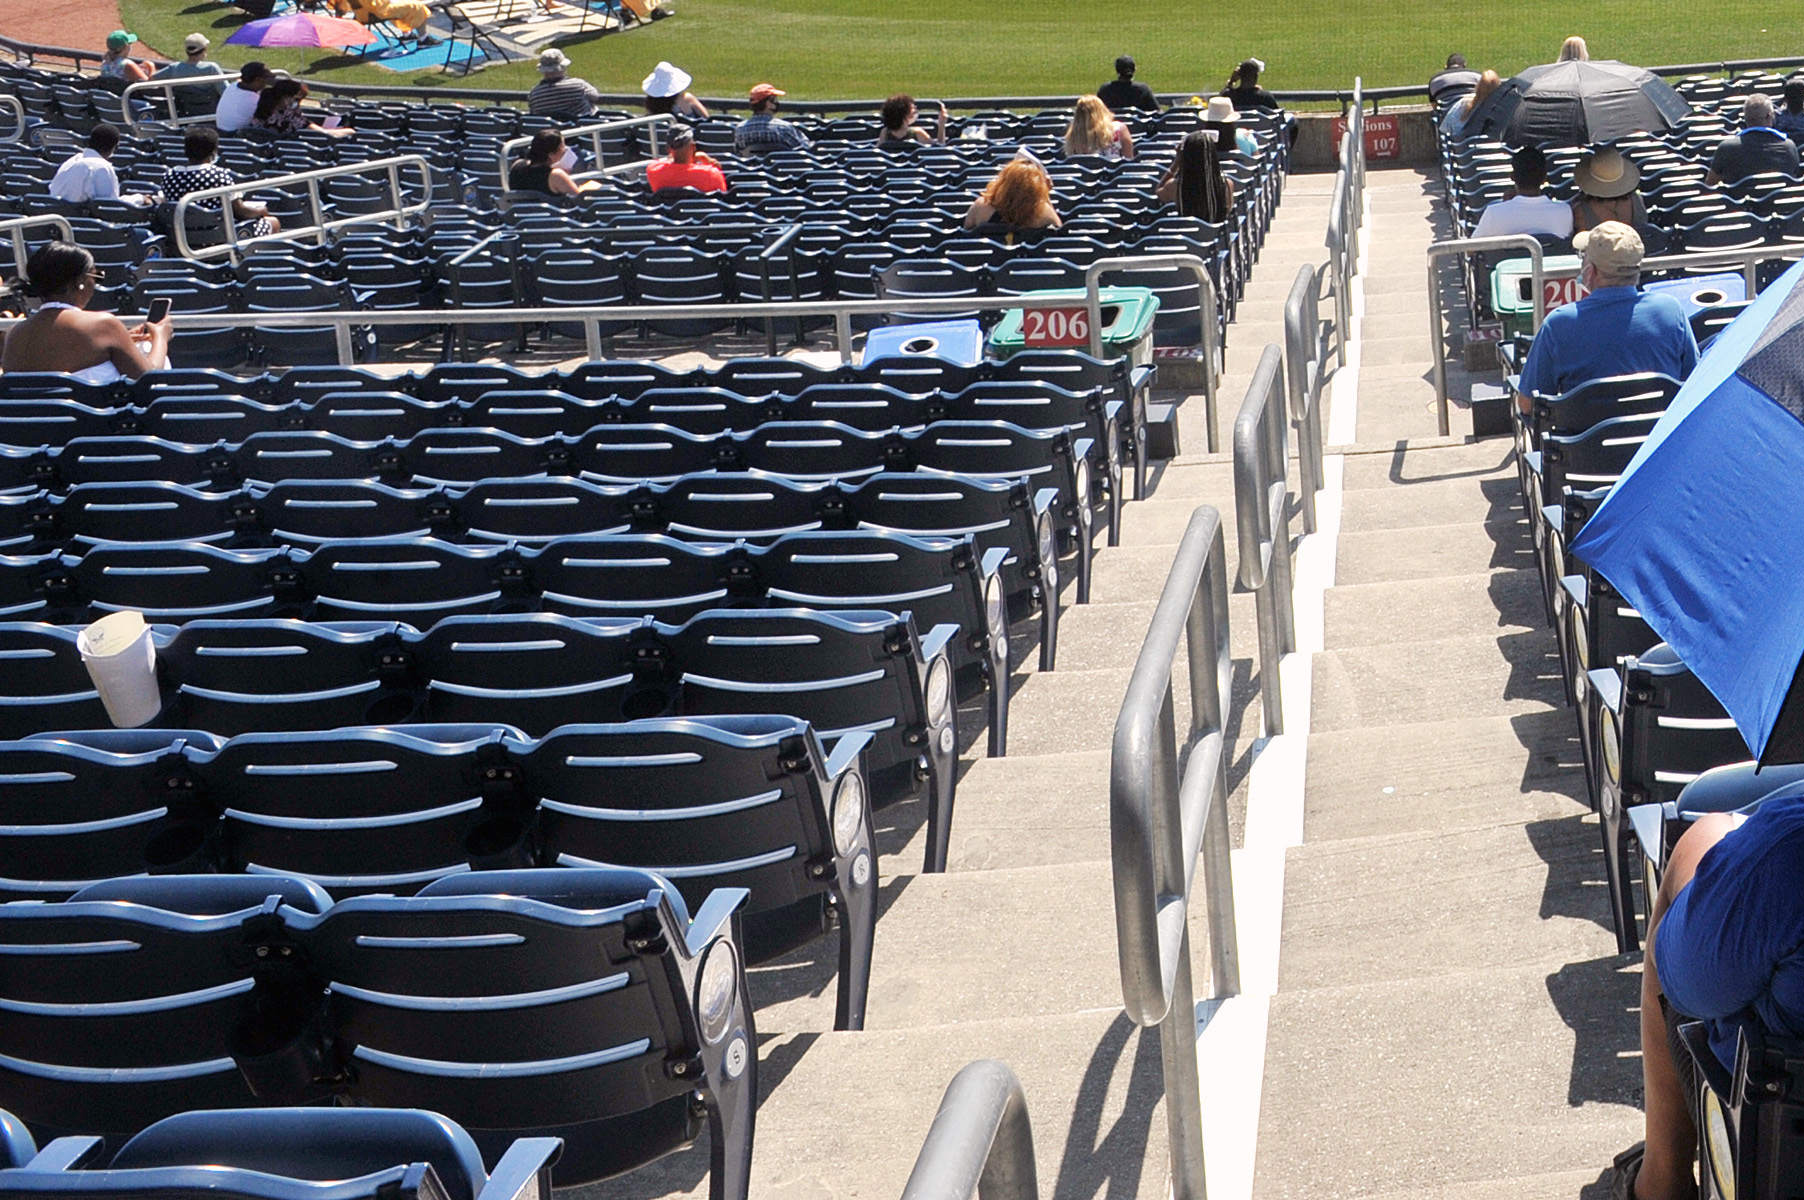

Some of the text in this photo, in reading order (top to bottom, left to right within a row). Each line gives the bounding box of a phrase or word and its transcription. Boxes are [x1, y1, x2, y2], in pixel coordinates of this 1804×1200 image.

[1338, 120, 1392, 133] Sions
[1373, 138, 1395, 151] 107
[1544, 278, 1584, 309] 20
[1026, 310, 1088, 340] 206
[733, 1049, 741, 1065] S
